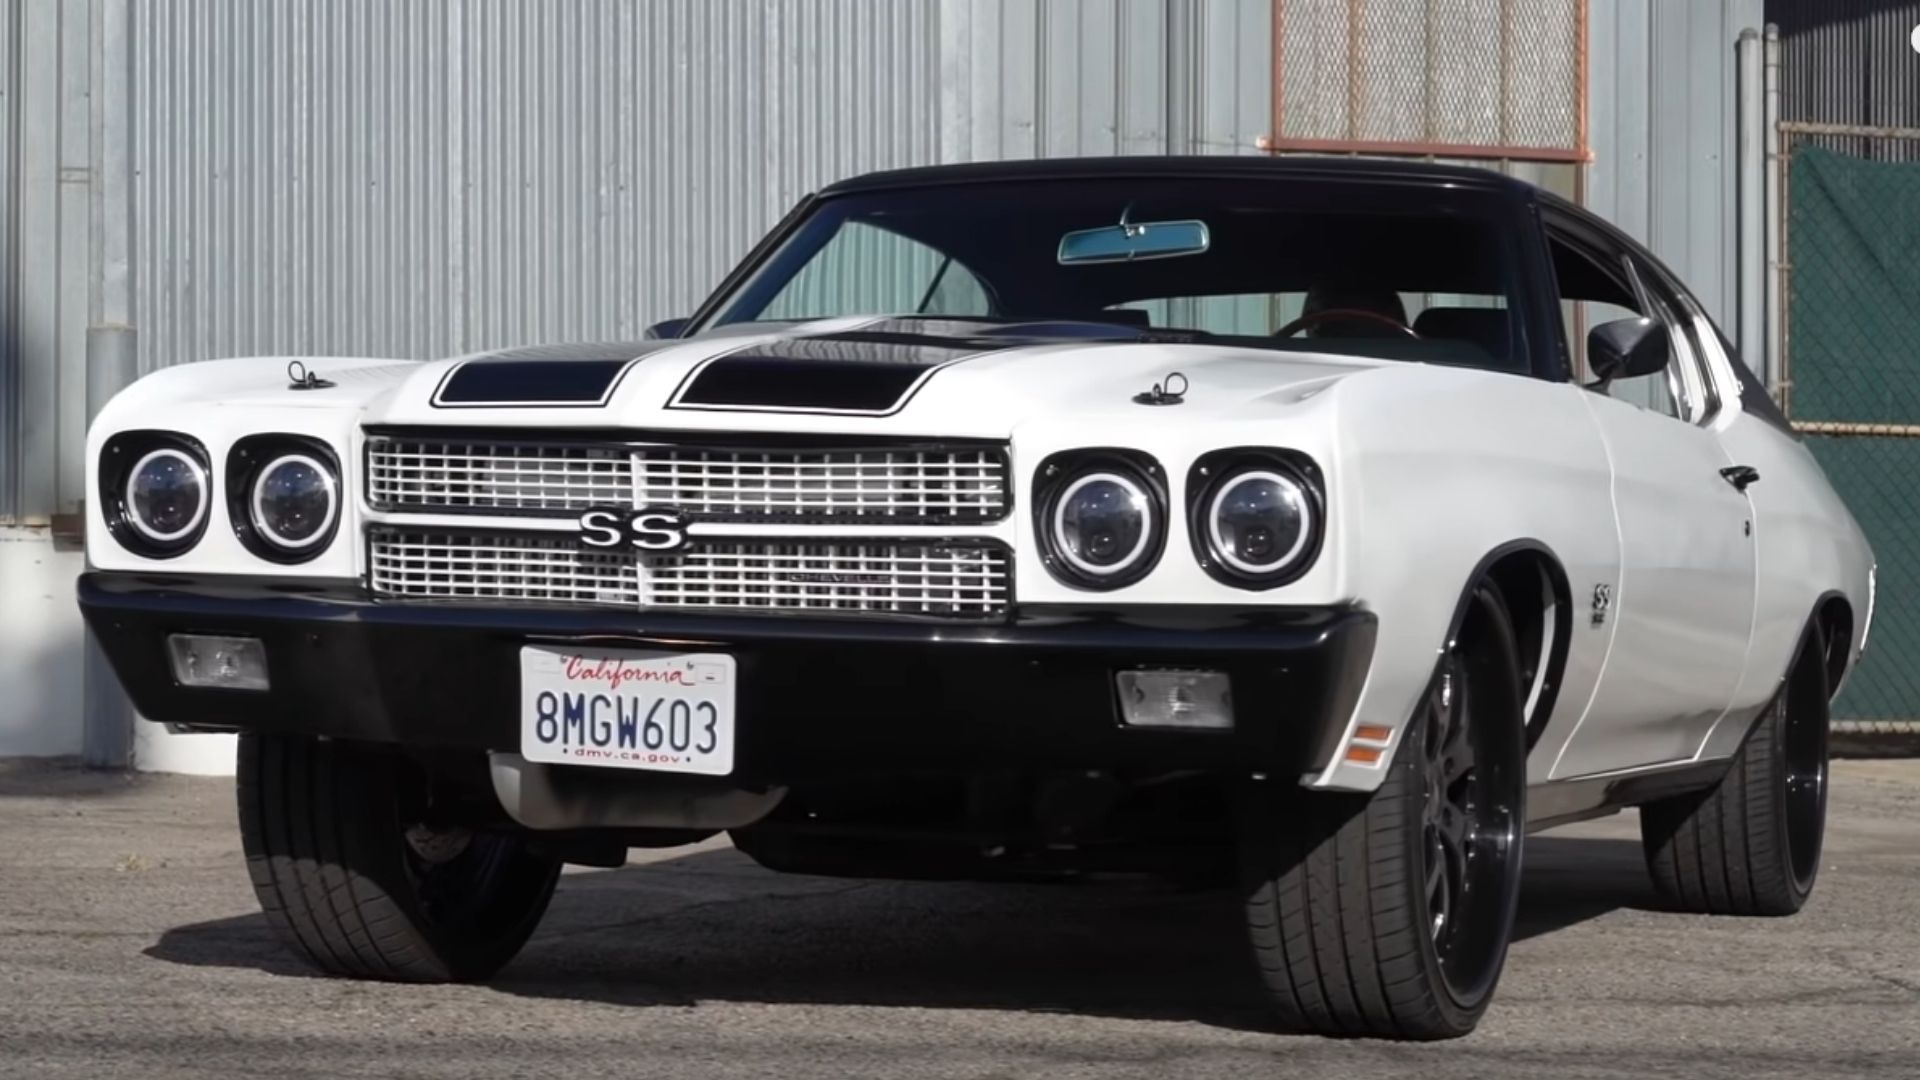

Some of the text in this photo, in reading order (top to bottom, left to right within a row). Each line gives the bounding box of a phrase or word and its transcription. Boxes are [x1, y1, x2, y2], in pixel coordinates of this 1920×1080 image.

[579, 510, 683, 551] SS
[565, 654, 696, 690] California
[536, 691, 718, 754] 8MGW603
[574, 749, 681, 763] dmv.ca.gov
